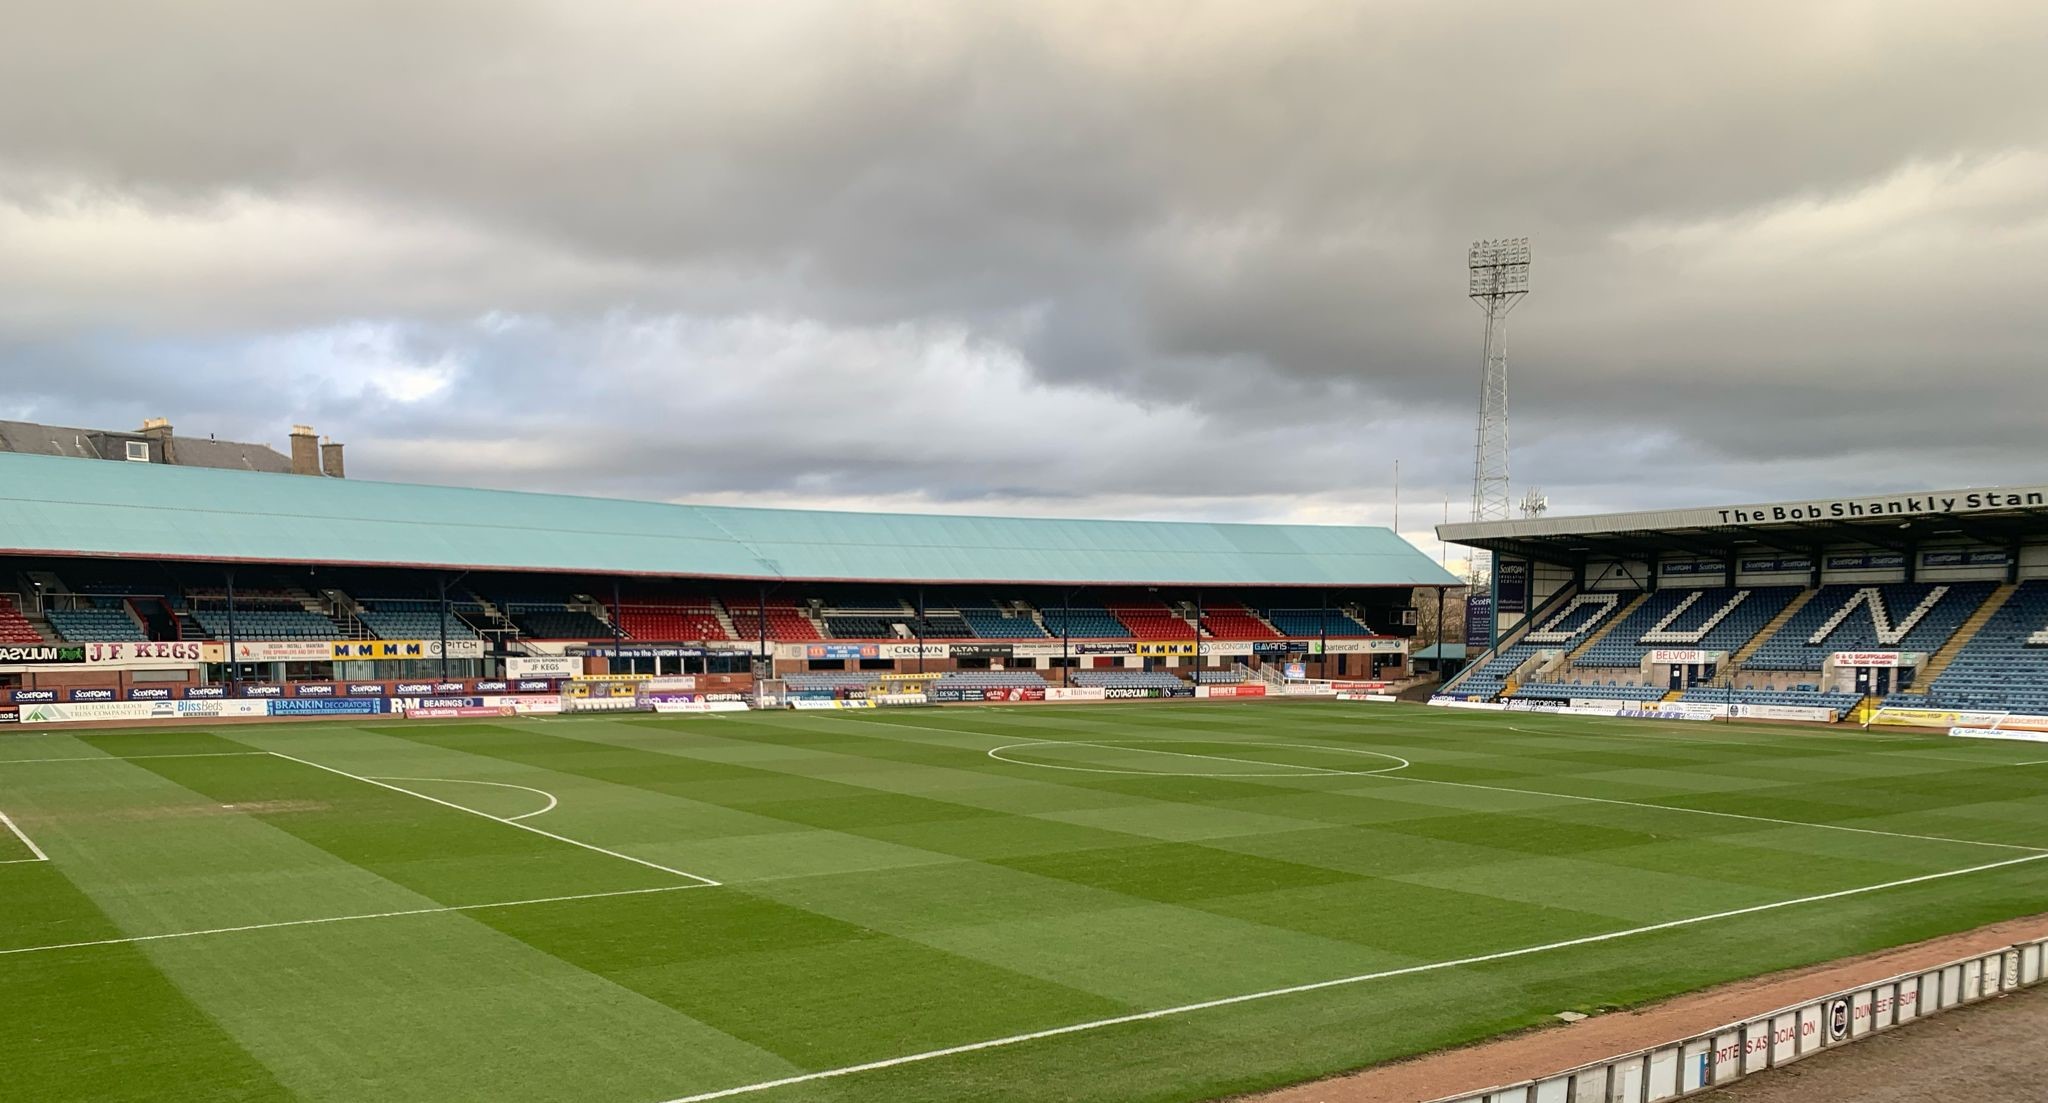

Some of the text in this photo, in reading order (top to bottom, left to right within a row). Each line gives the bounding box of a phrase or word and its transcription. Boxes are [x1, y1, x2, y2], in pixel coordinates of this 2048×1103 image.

[1718, 492, 2043, 524] The Bob Shankly Stan
[134, 643, 200, 660] KEGS
[894, 645, 943, 654] CROWN
[541, 663, 559, 671] KEGS
[706, 693, 741, 701] GRIFFIN
[275, 699, 323, 709] BRANKIN
[423, 699, 463, 708] BEARINGS
[1854, 1002, 1888, 1020] DUNEE
[1715, 1039, 1753, 1066] ORTES
